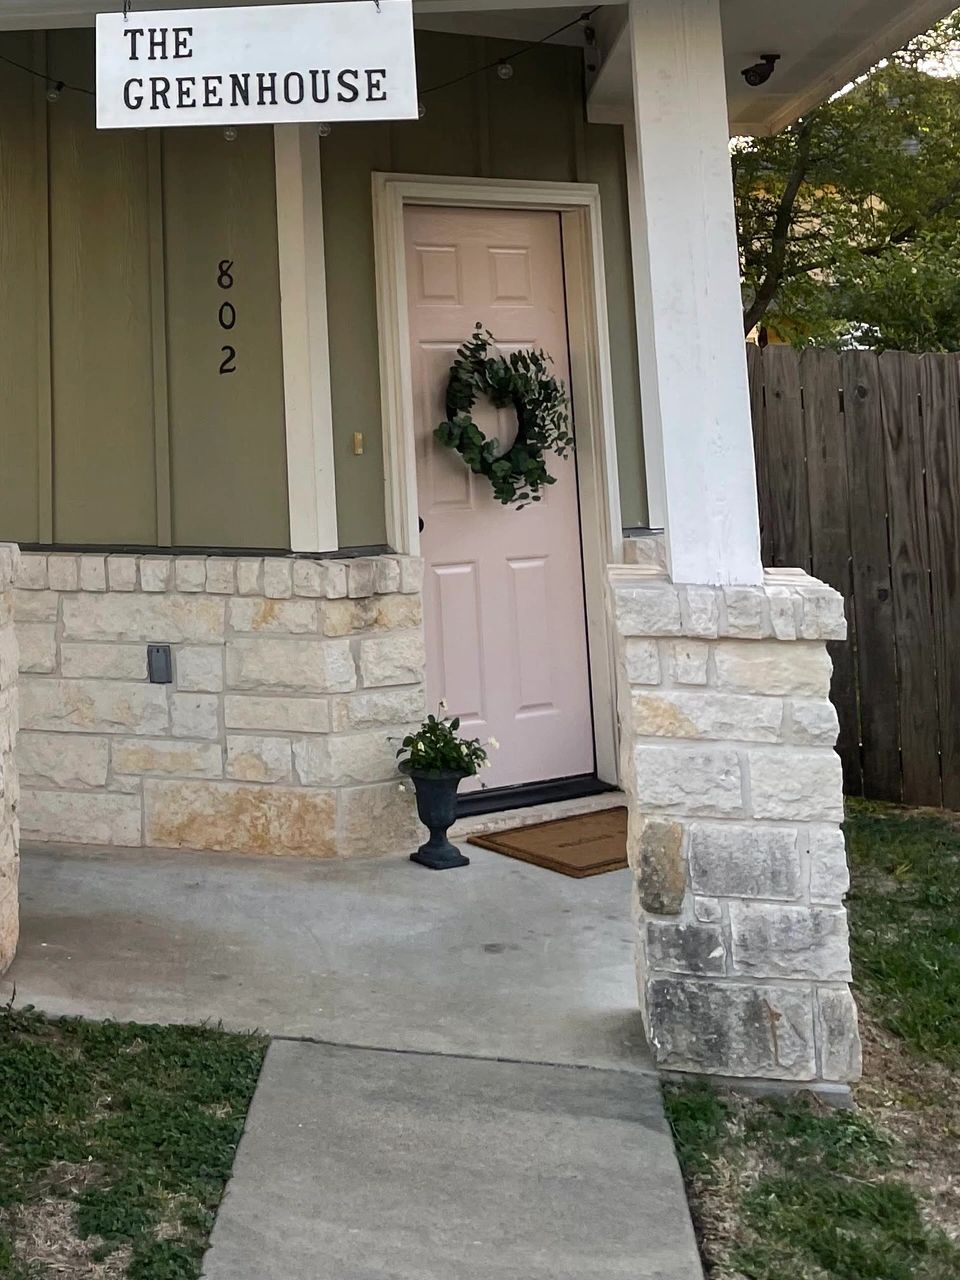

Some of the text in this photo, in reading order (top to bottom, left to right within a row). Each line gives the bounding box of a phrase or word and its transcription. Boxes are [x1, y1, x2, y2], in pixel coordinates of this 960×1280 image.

[123, 27, 193, 60] THE
[123, 69, 387, 110] GREENHOUSE
[217, 259, 236, 375] 802
